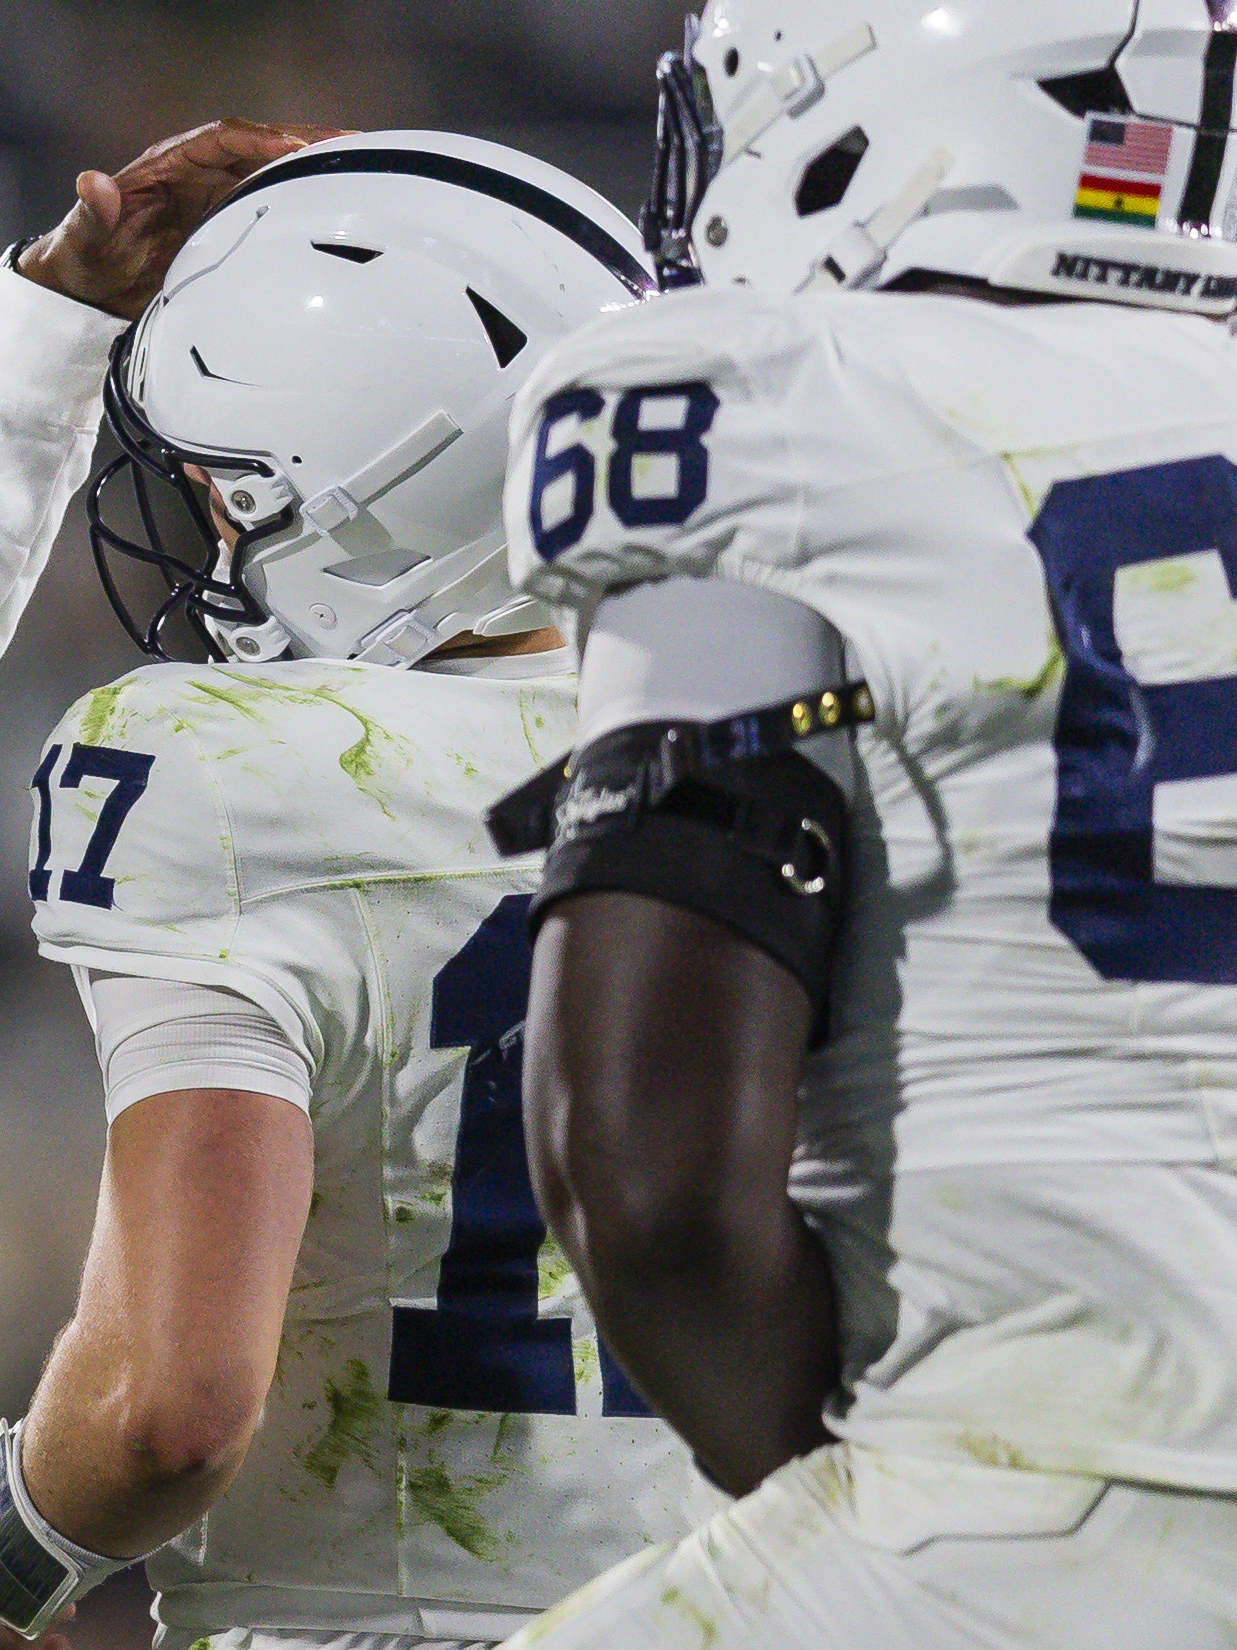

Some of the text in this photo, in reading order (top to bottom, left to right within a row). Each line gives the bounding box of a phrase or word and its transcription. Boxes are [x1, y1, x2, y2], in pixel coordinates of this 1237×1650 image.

[1051, 251, 1202, 297] NITTANY
[529, 378, 721, 563] 68
[28, 742, 156, 910] 17
